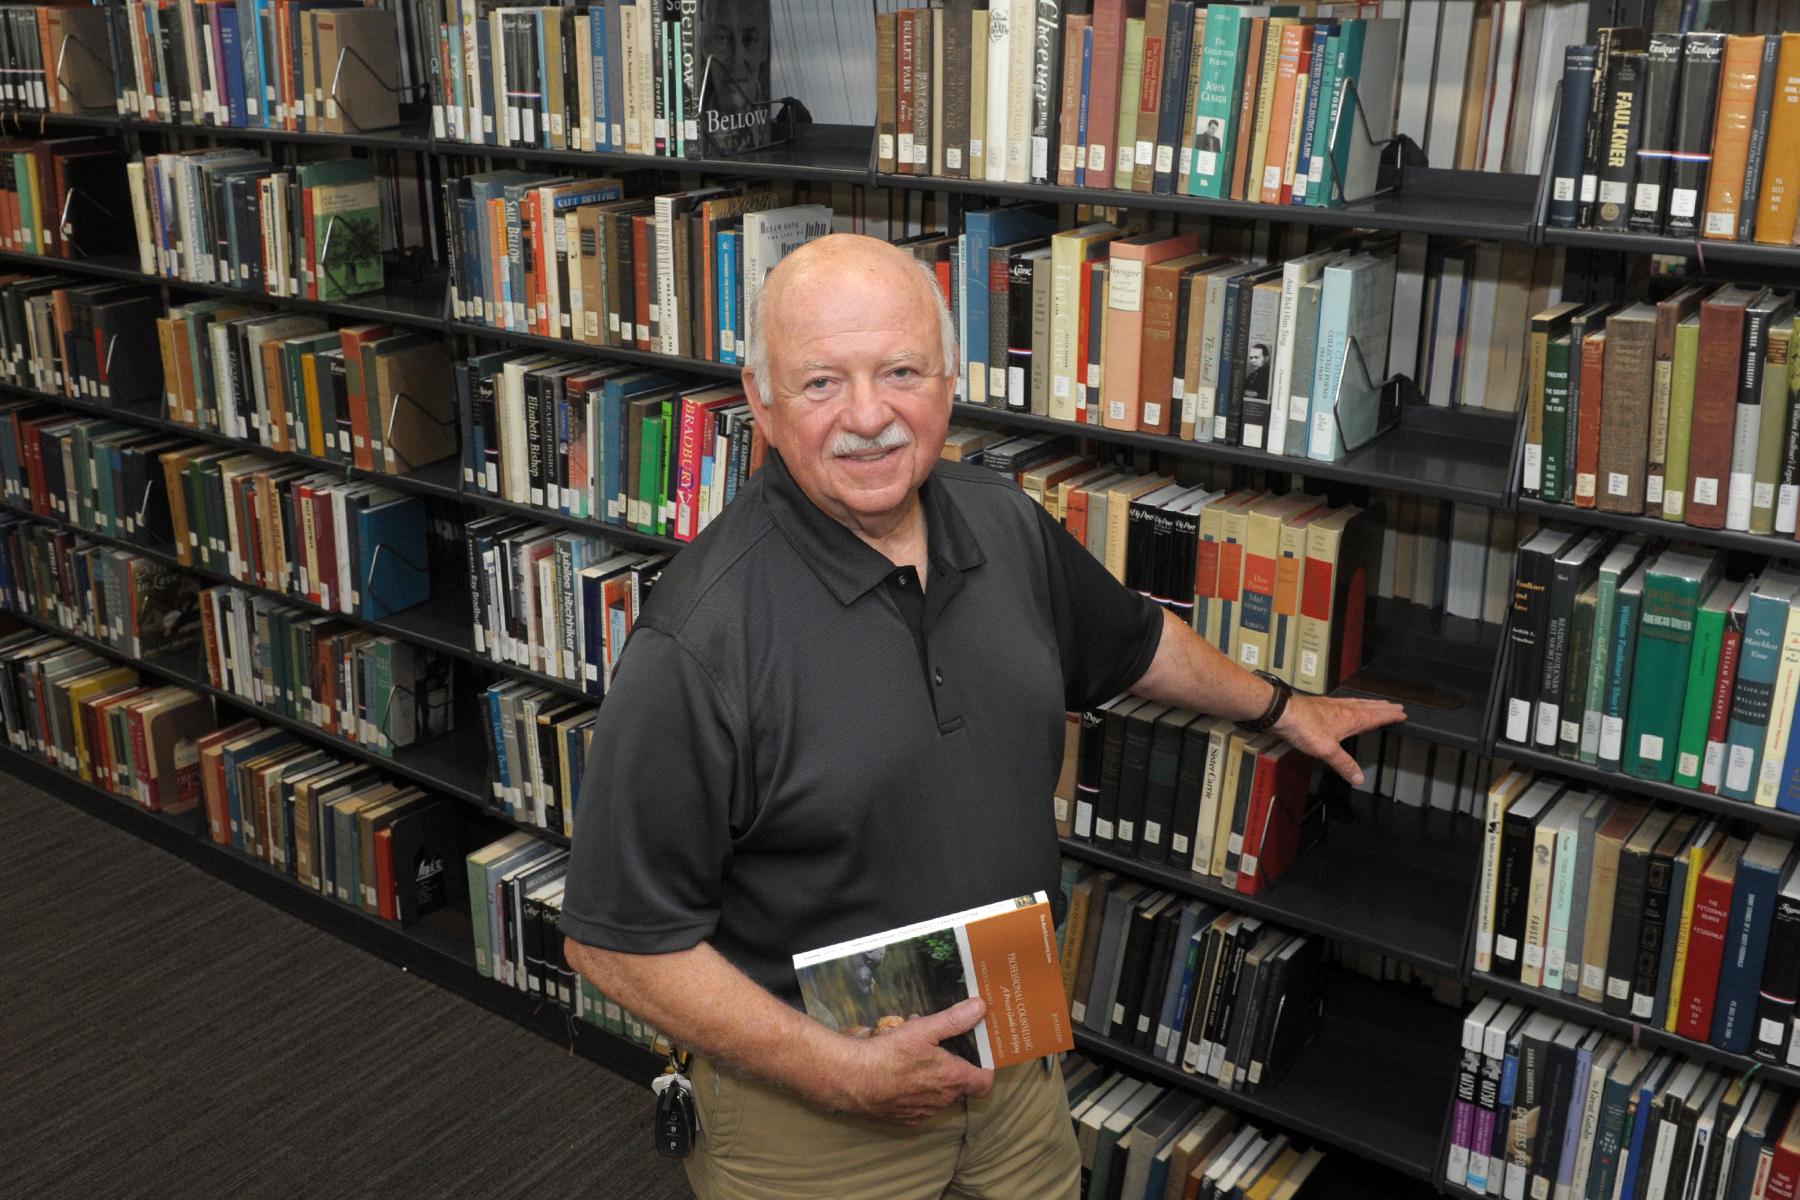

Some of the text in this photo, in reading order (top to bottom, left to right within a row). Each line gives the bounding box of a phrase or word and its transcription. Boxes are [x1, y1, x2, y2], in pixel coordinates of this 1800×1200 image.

[902, 20, 913, 93] BULLET PARK
[1035, 0, 1060, 107] Cheever
[1204, 47, 1235, 57] COLLECTED
[1209, 57, 1228, 66] POEMS
[1313, 44, 1325, 76] WALTER
[1204, 81, 1226, 92] JOHN
[1310, 79, 1320, 96] VAN
[1201, 91, 1227, 104] CIARDI
[1330, 90, 1340, 122] POEMS
[1609, 91, 1634, 168] FAULKNER
[1302, 133, 1313, 159] CLARK
[558, 188, 618, 208] SAUL BELLOW
[506, 201, 520, 265] SAUL BELLOW
[1279, 279, 1295, 346] And Bid Him Sing
[1745, 317, 1760, 389] FAULKNER, MISSISSIPPI
[1661, 366, 1670, 380] The
[1553, 388, 1568, 396] SOUND
[1791, 402, 1800, 430] William
[527, 395, 540, 477] Elizabeth Bishop
[680, 400, 697, 488] BRADBURY
[1655, 438, 1666, 457] Myth
[1788, 430, 1799, 464] Faulkner's
[559, 547, 571, 588] jubilee
[1253, 573, 1268, 584] Dos
[1516, 579, 1546, 592] Faulkner
[1514, 592, 1528, 600] and
[1243, 601, 1269, 616] century
[1514, 602, 1528, 612] Love
[563, 589, 574, 651] hitchhiker
[1642, 611, 1693, 632] AMERICAN WRITER
[1512, 626, 1530, 636] Judith
[1755, 627, 1770, 637] One
[1744, 636, 1779, 651] Matchless
[1544, 619, 1558, 690] BEST SHORT STORIES
[1551, 617, 1566, 694] READING FAULKNER'S
[1611, 605, 1632, 712] William Faulkner's Short
[1750, 650, 1768, 660] Time
[1715, 638, 1736, 720] WILLIAM FAULKNER
[1743, 686, 1758, 694] LIFE
[1735, 695, 1769, 707] WILLIAM
[1733, 706, 1766, 719] FAULKNER
[1205, 746, 1218, 800] Sister Carrie
[1696, 903, 1729, 918] FITZGERALD
[1708, 899, 1719, 907] THE
[1701, 913, 1720, 924] READER
[1528, 915, 1540, 946] FAUSET
[1693, 926, 1725, 941] FITZGERALD
[1003, 994, 1013, 1012] Process
[1007, 951, 1034, 1051] PROFESSIONAL COUNSELING
[1006, 1012, 1015, 1028] Guide
[1010, 1034, 1021, 1054] Helping
[1525, 1047, 1536, 1104] SARAH CHURCHWELL
[1458, 1072, 1476, 1101] GATSBY
[1480, 1080, 1497, 1109] GATSBY
[1582, 1087, 1600, 1139] Great Gatsby
[1514, 1106, 1529, 1167] CARELESS PEO
